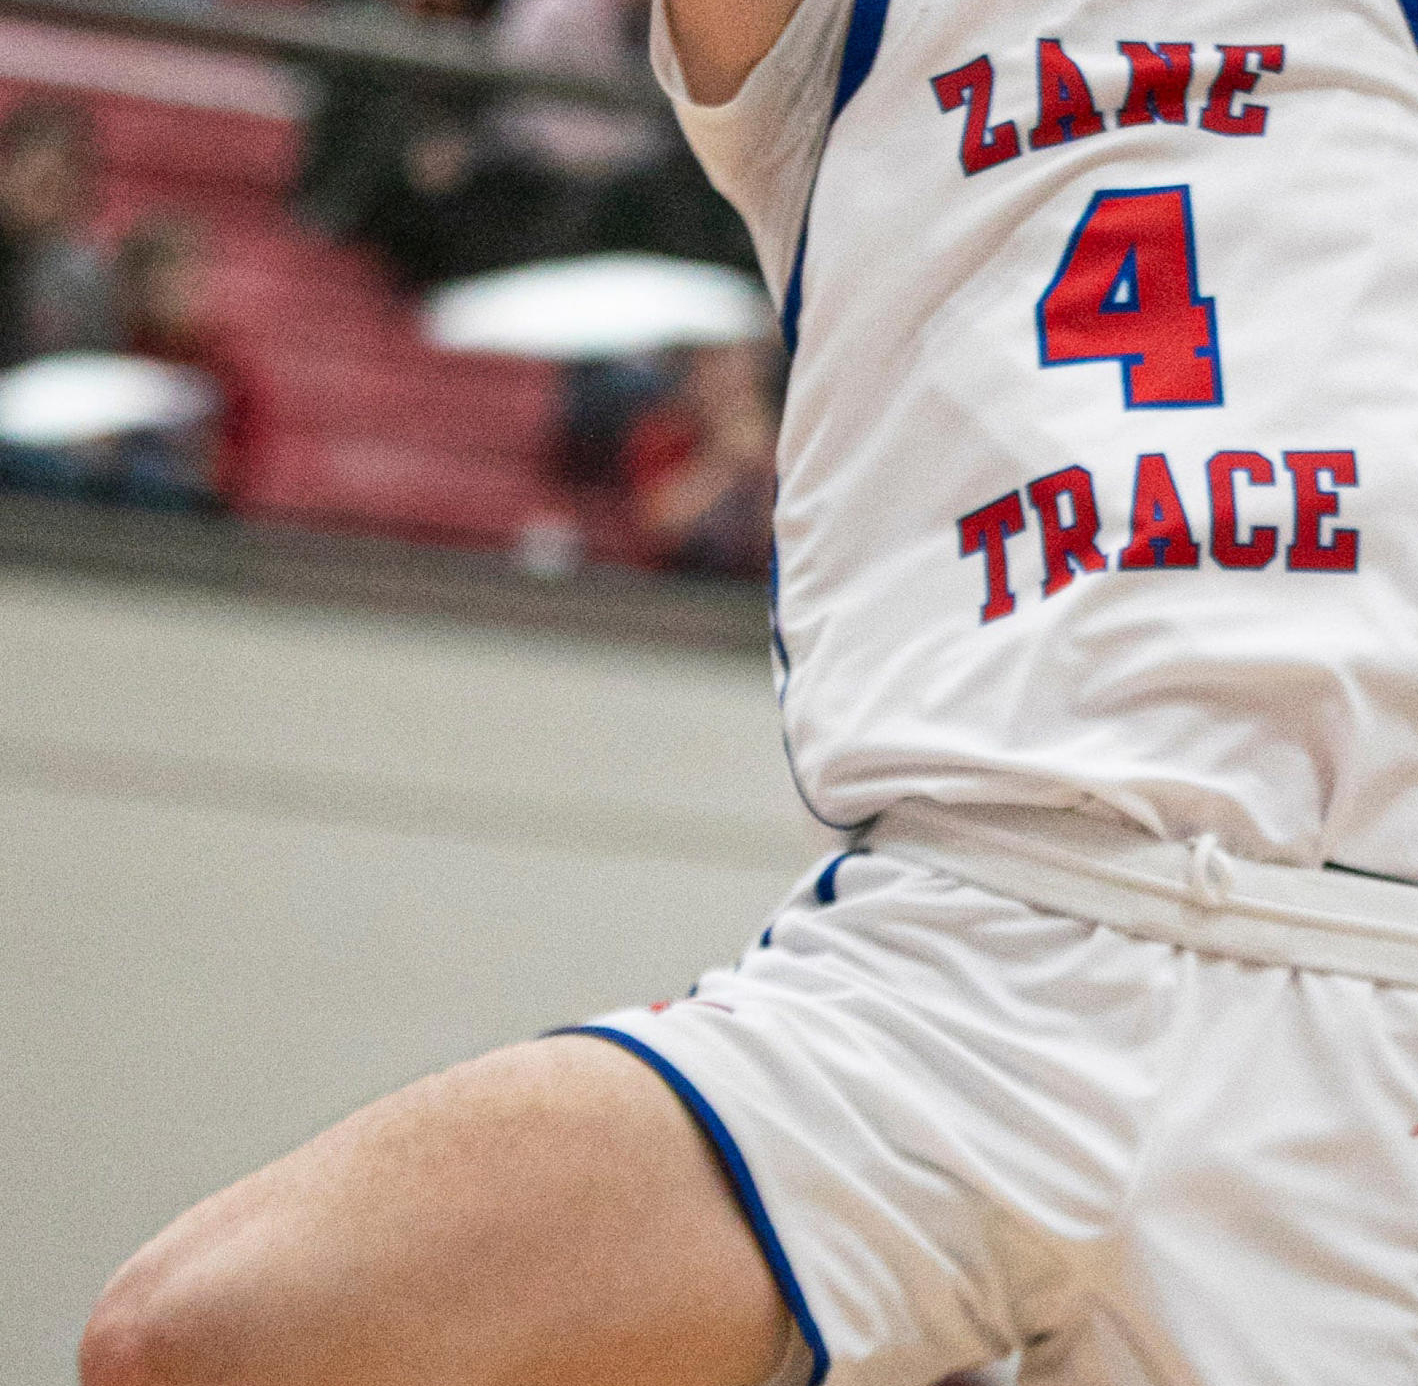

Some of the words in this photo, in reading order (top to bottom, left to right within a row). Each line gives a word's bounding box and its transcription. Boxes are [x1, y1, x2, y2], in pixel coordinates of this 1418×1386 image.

[930, 37, 1285, 177] ZANE
[1035, 184, 1225, 411] 4
[956, 449, 1360, 626] TRACE
